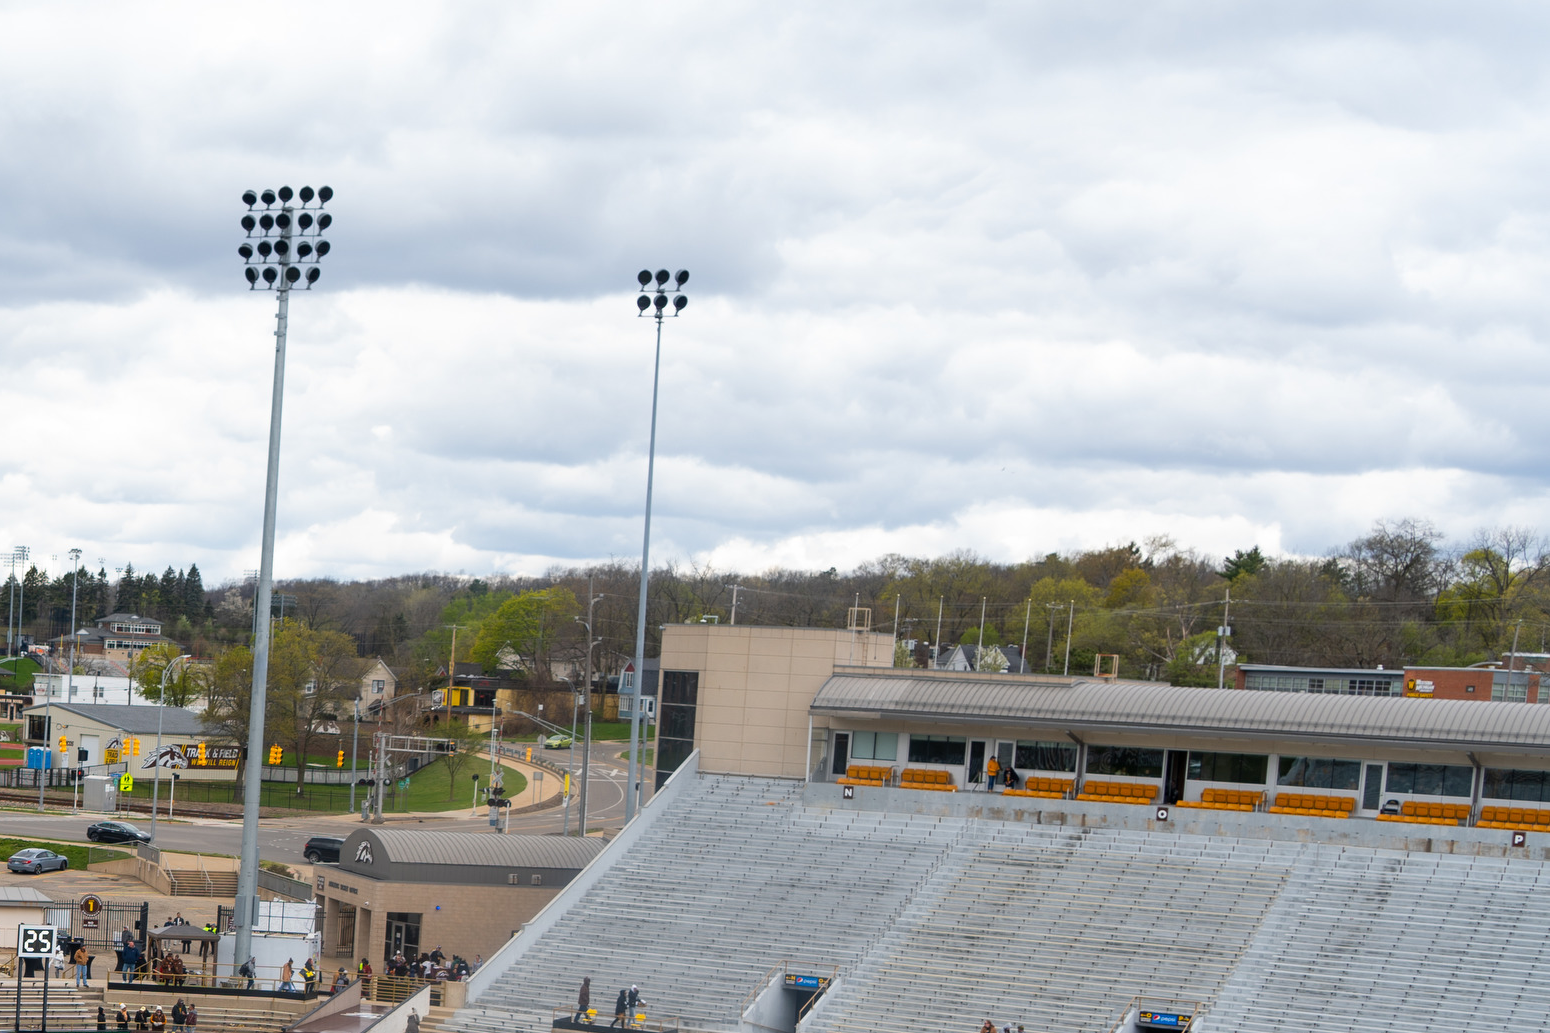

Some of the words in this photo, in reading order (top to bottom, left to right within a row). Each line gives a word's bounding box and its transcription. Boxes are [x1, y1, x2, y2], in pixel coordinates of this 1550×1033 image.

[186, 747, 212, 758] TRAK
[844, 788, 853, 797] N
[1514, 834, 1524, 844] P
[24, 930, 51, 952] 25
